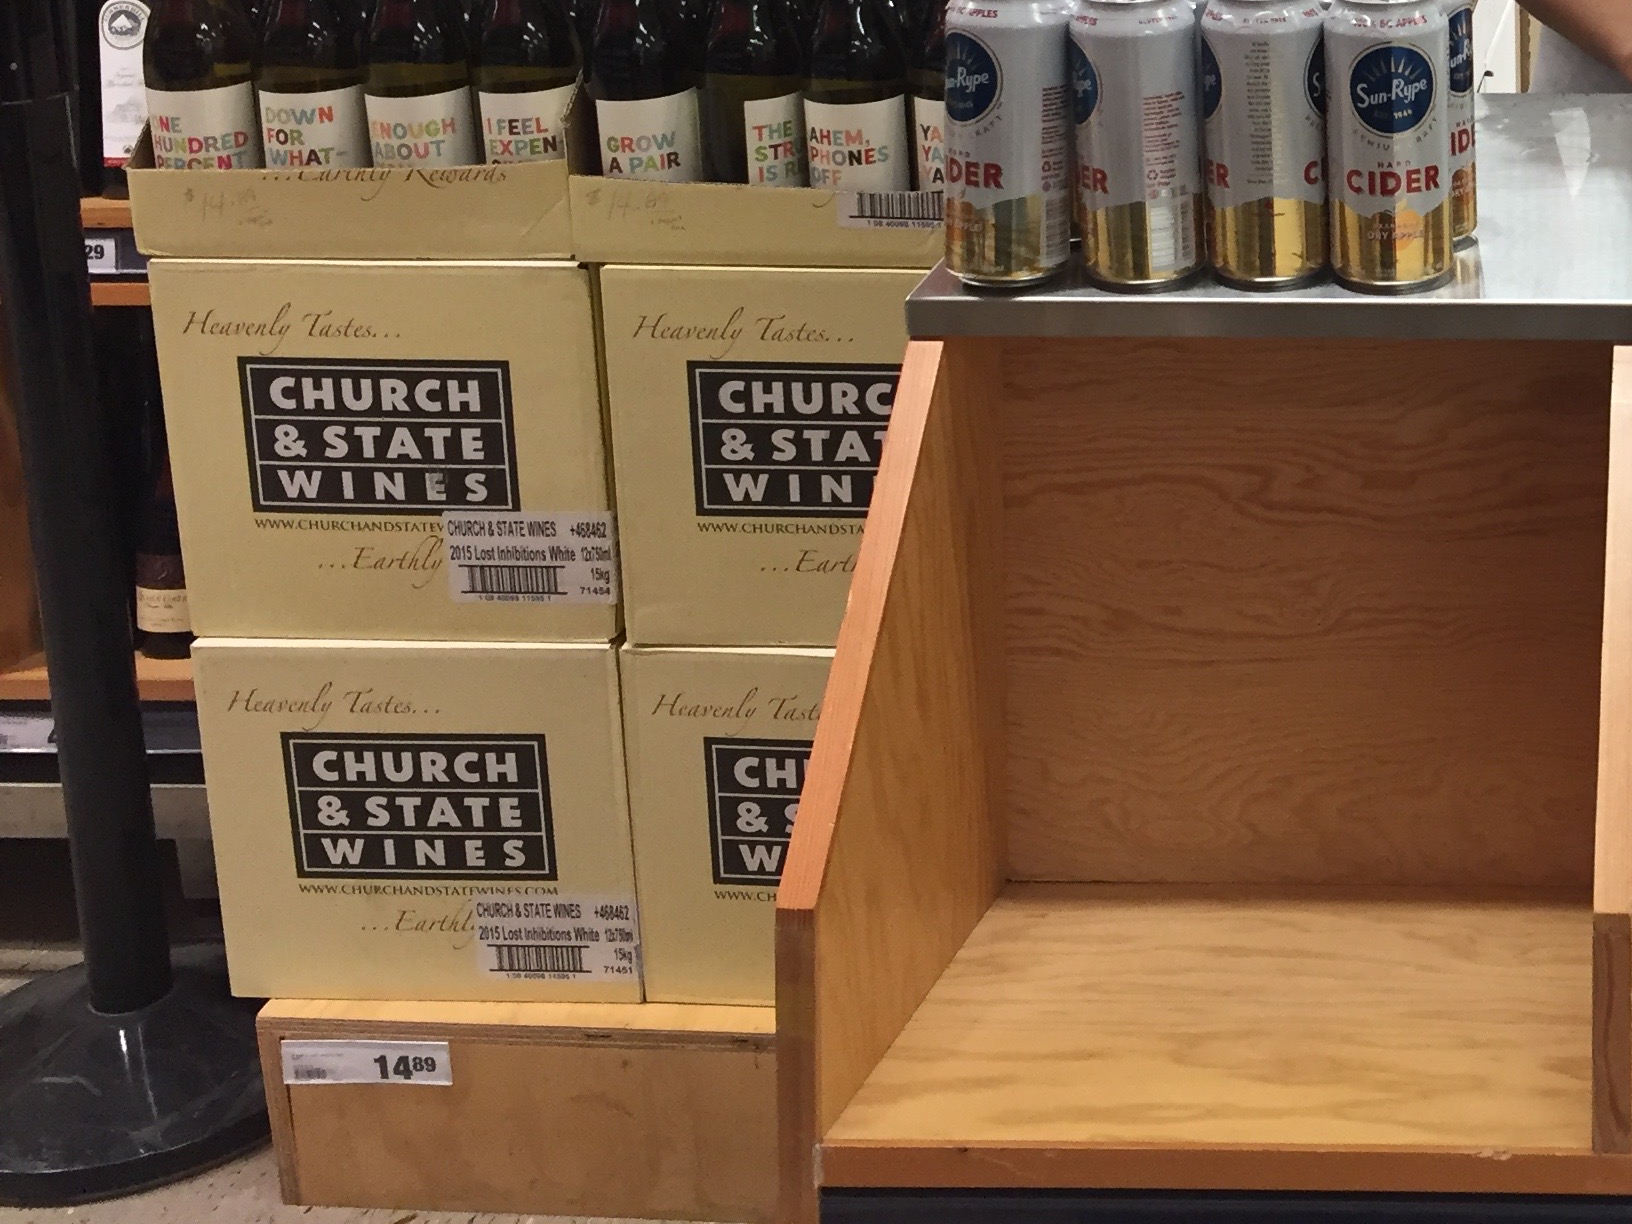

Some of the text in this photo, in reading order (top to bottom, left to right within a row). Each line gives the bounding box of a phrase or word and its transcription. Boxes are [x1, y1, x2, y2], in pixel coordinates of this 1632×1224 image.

[1356, 78, 1428, 109] Sun-Rype
[265, 105, 334, 126] DOWN
[486, 117, 549, 135] I FEEL
[153, 131, 248, 155] HUNDRED
[266, 127, 305, 146] FOR
[607, 130, 676, 153] GROW
[752, 120, 793, 141] THE
[809, 126, 871, 147] AHEM,
[374, 139, 445, 160] ABOUT
[609, 152, 681, 174] A PAIR
[809, 145, 889, 167] PHONES
[810, 166, 841, 185] OFF
[1346, 164, 1440, 197] CIDER
[182, 302, 291, 355] Heavenly
[632, 306, 744, 360] Heavenly
[269, 376, 482, 412] CHURCH
[718, 380, 894, 416] CHURC
[273, 424, 485, 460] & STATE
[720, 428, 755, 462] &
[277, 470, 489, 503] WINES
[448, 520, 556, 537] CHURCH & STATE WINES
[450, 545, 576, 562] 2015 Lost Inhibitions White
[228, 682, 333, 733] Heavenly
[652, 686, 758, 736] Heavenly
[312, 750, 519, 784] CHURCH
[316, 794, 523, 828] & STATE
[736, 801, 769, 833] &
[320, 836, 526, 867] WINES
[476, 902, 581, 919] CHURCH & STATE WINES
[479, 926, 600, 942] 2015 Lost Inhibitions White
